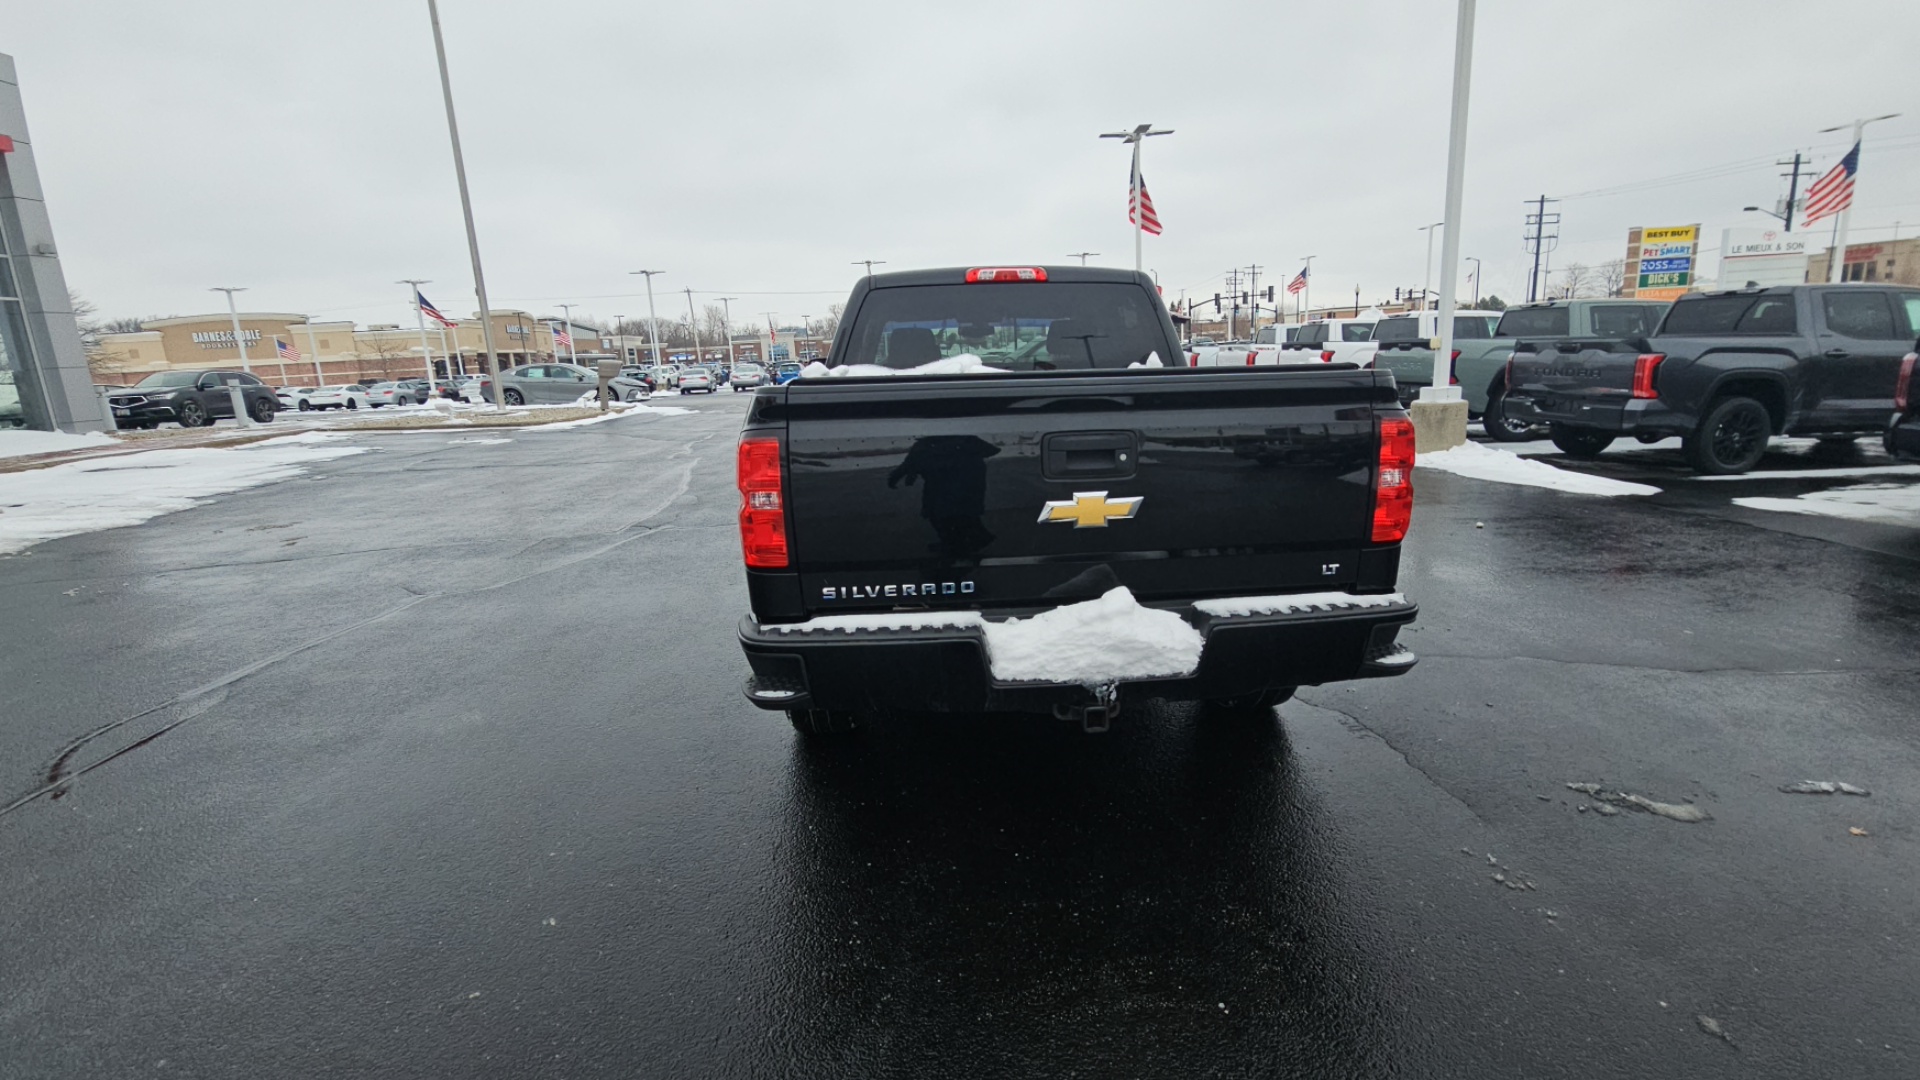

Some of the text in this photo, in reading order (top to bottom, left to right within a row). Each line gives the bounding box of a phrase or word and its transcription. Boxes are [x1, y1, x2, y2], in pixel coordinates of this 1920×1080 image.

[1732, 245, 1742, 253] LE
[1746, 244, 1772, 252] MIEUX
[1786, 242, 1804, 251] SON
[1641, 261, 1669, 270] ROSS
[1648, 273, 1679, 285] DICK'S
[191, 331, 226, 343] BARNES
[1533, 367, 1601, 378] TUNDRA
[1322, 563, 1340, 575] LT
[822, 581, 975, 599] SILVERADO
